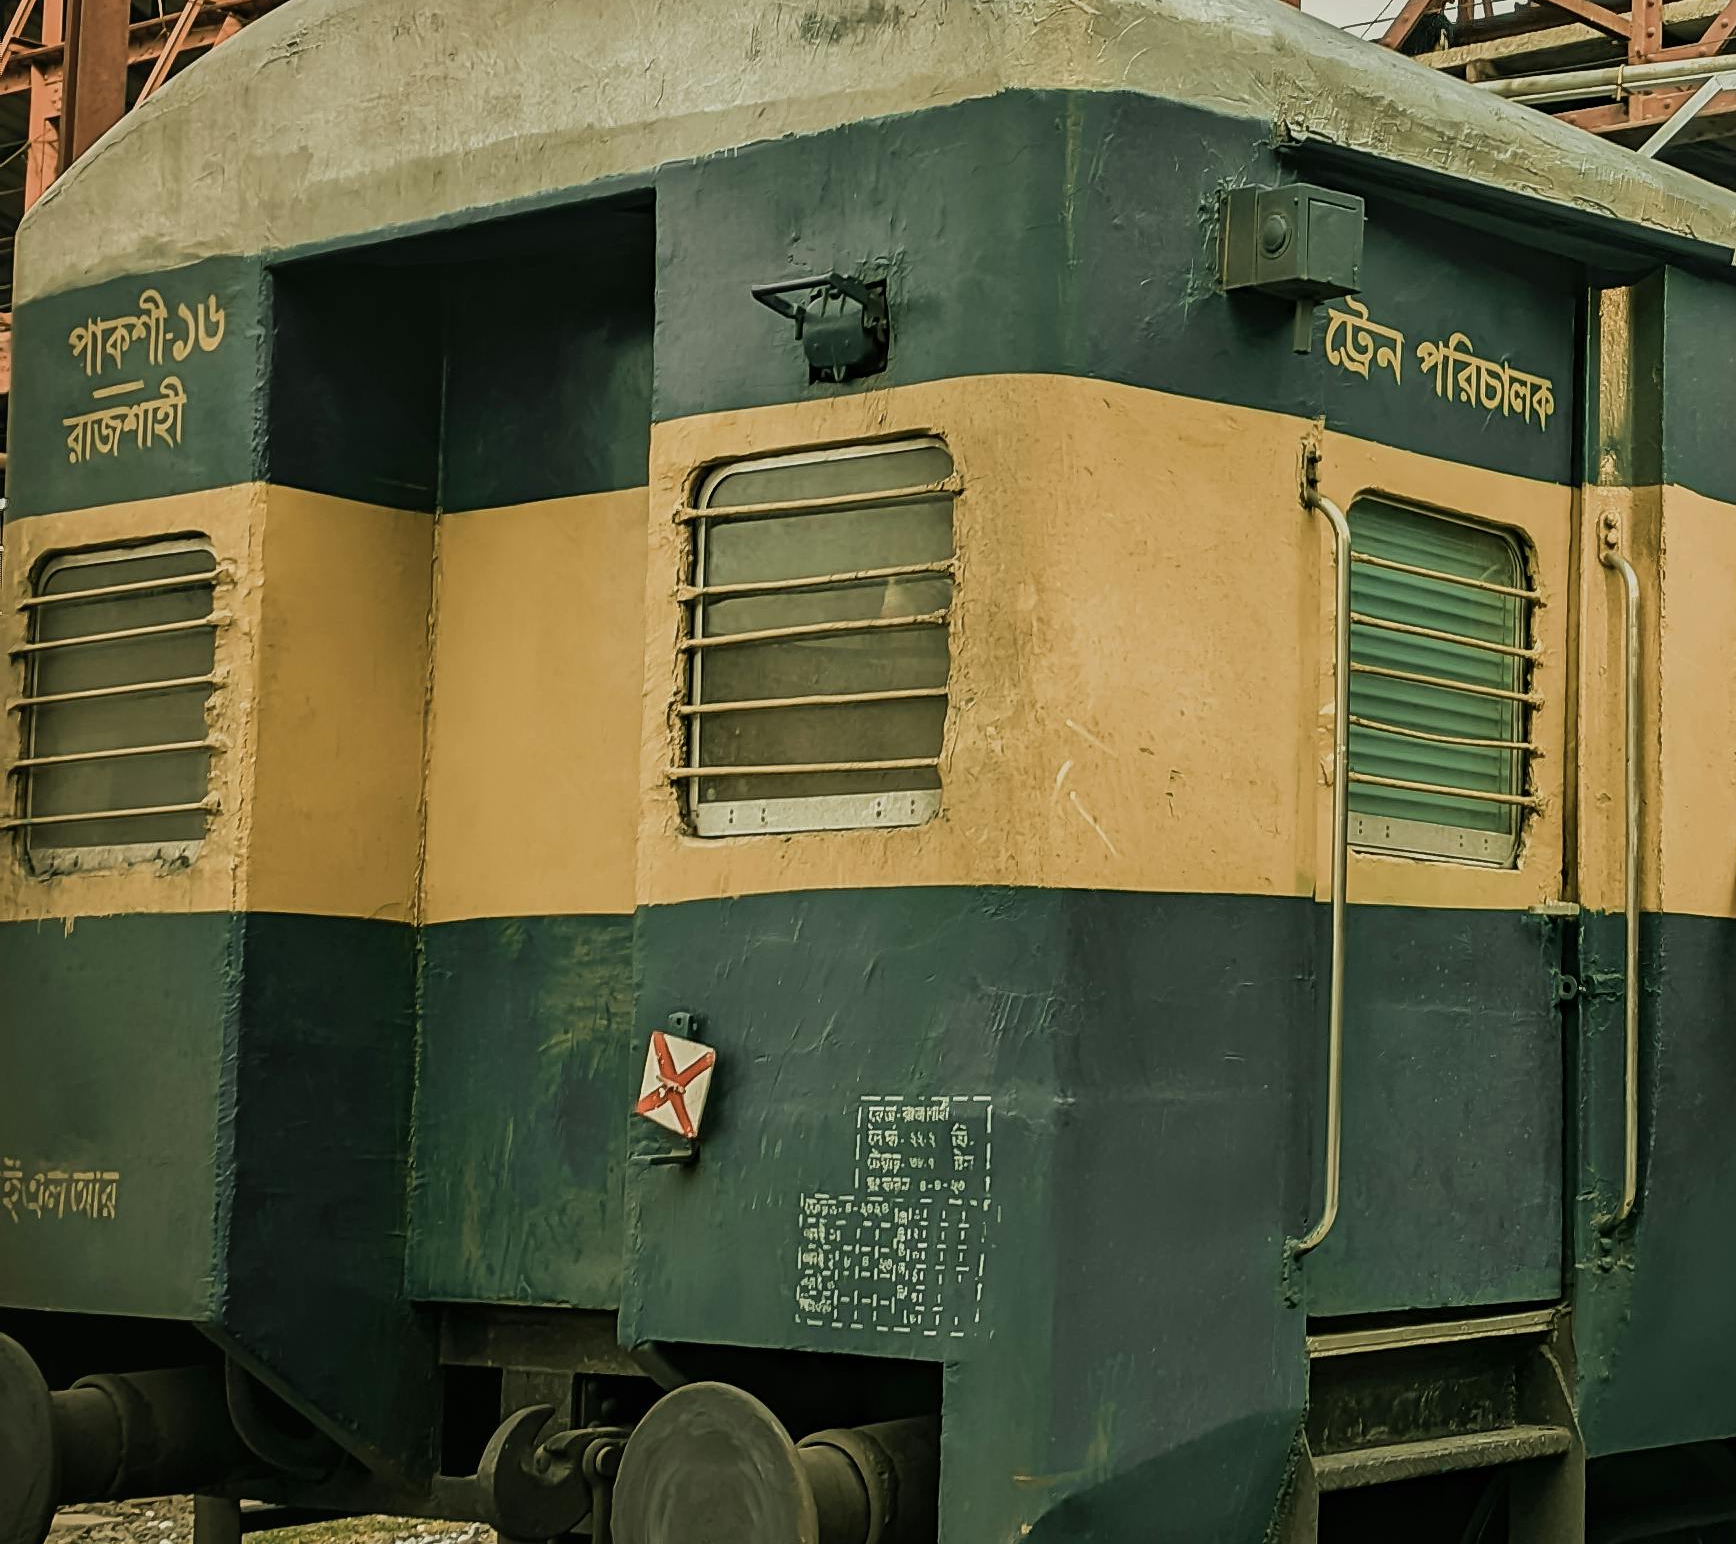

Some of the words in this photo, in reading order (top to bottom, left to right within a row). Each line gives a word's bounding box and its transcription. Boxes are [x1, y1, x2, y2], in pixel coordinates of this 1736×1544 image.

[68, 288, 225, 377] পাকশী-১৬
[1325, 295, 1405, 386] ট্রেন
[1416, 331, 1555, 433] পরিচালক
[63, 375, 188, 464] রাজশাহী
